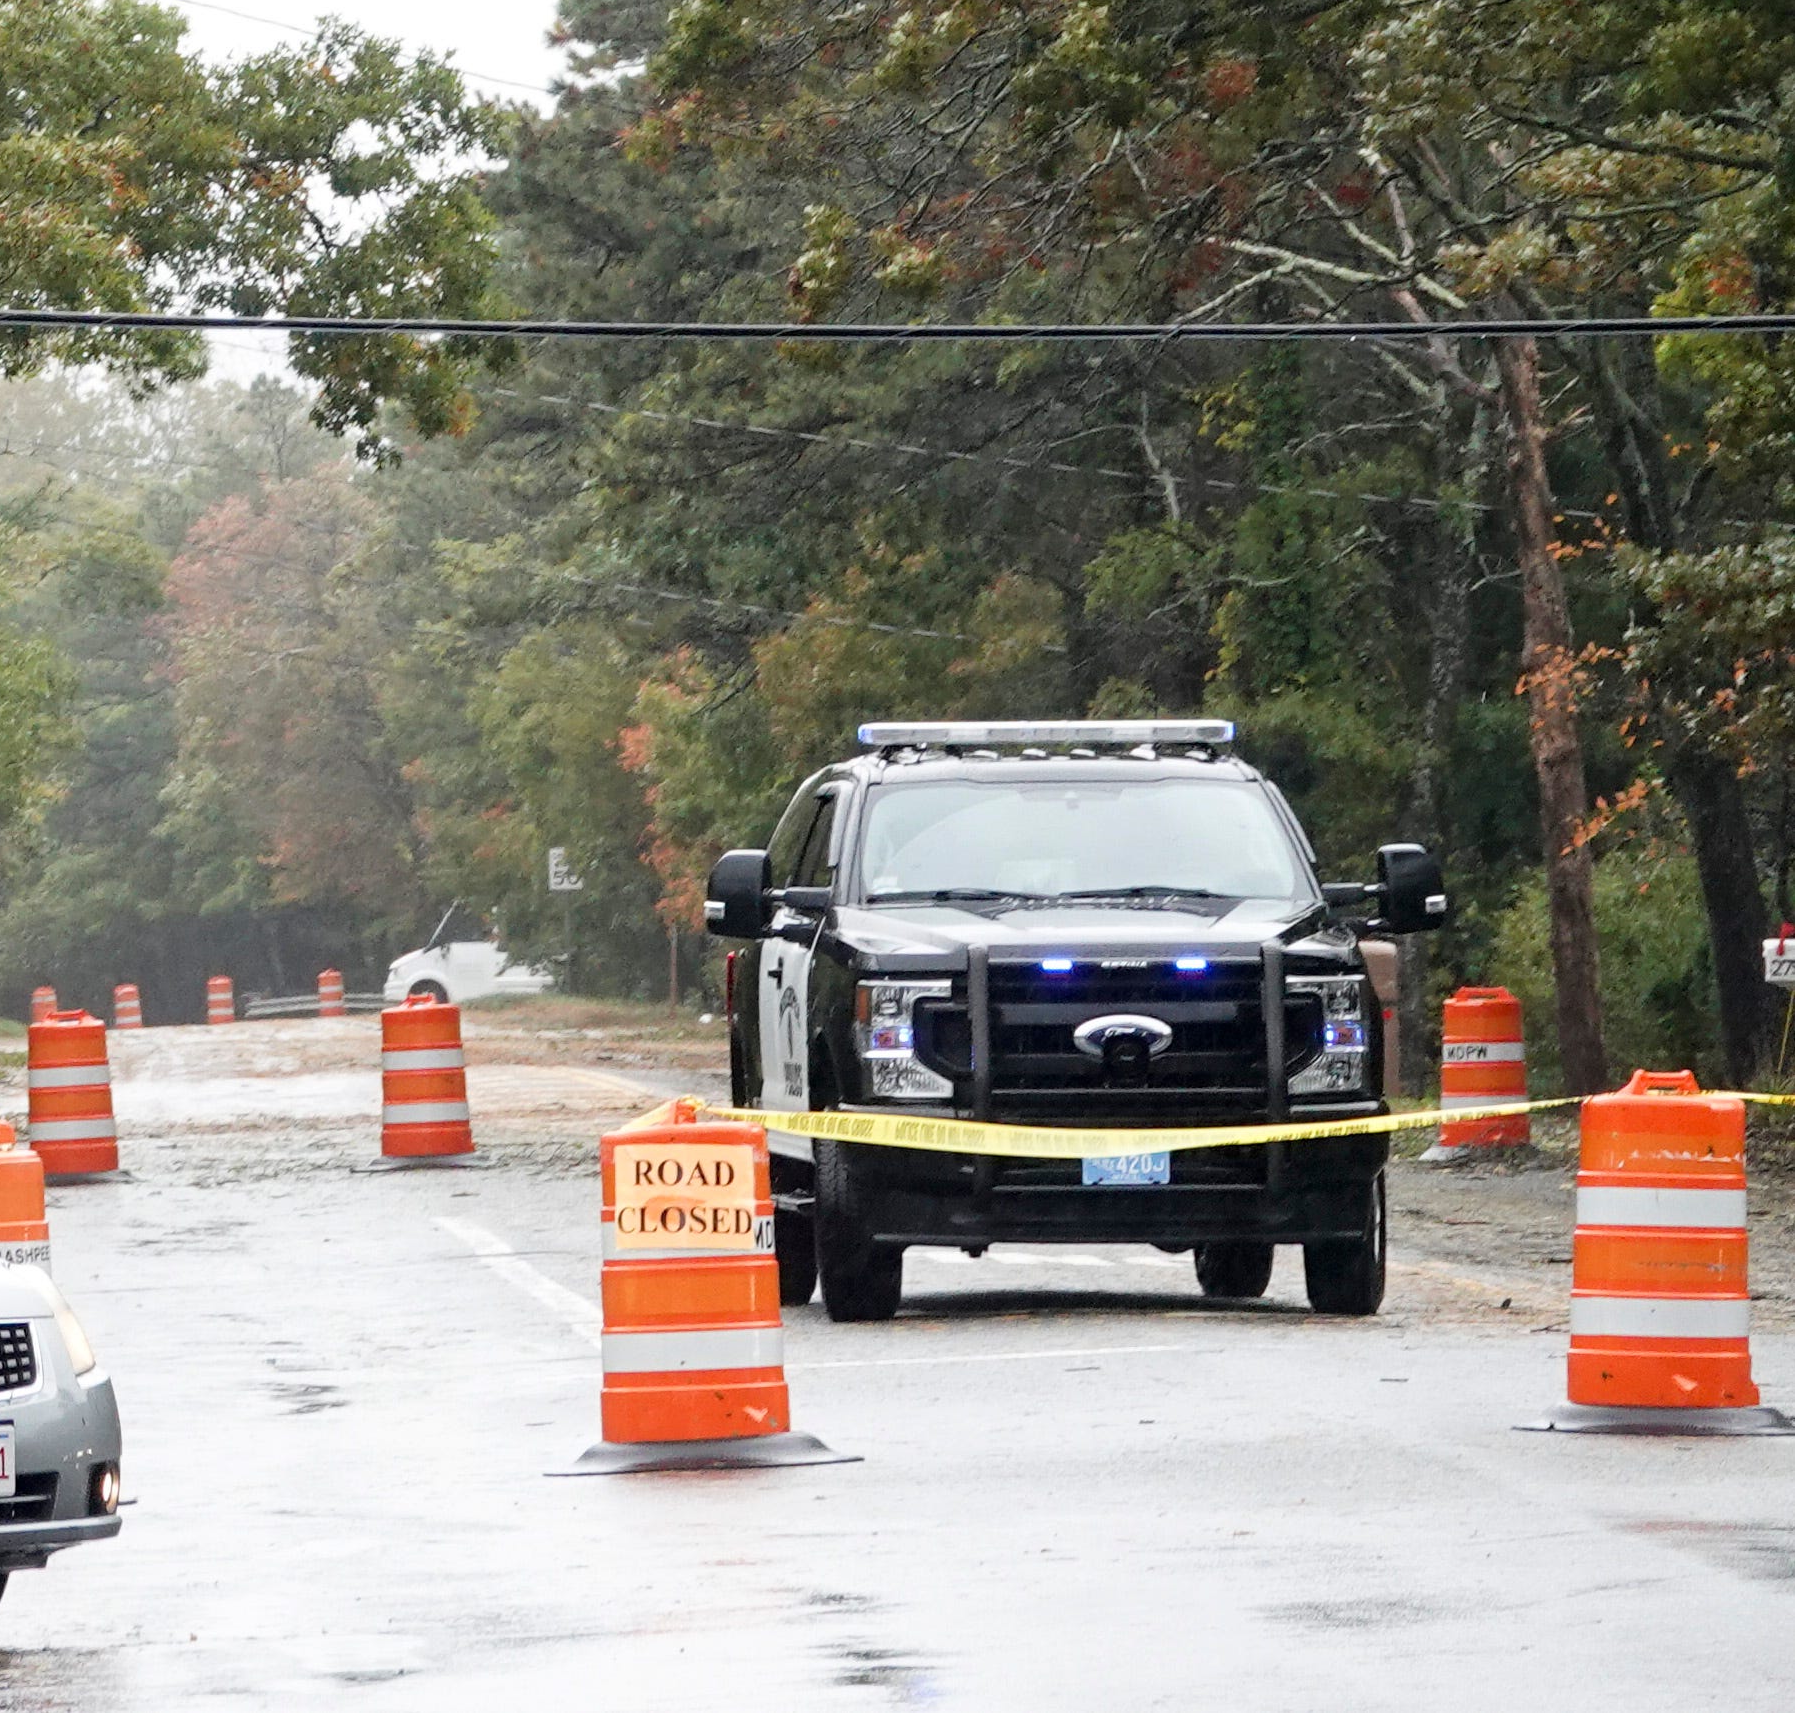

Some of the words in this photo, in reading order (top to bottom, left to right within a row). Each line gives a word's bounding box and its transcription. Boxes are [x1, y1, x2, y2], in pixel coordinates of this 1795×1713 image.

[1770, 959, 1795, 976] 27
[634, 1159, 735, 1187] ROAD
[617, 1206, 752, 1235] CLOSED
